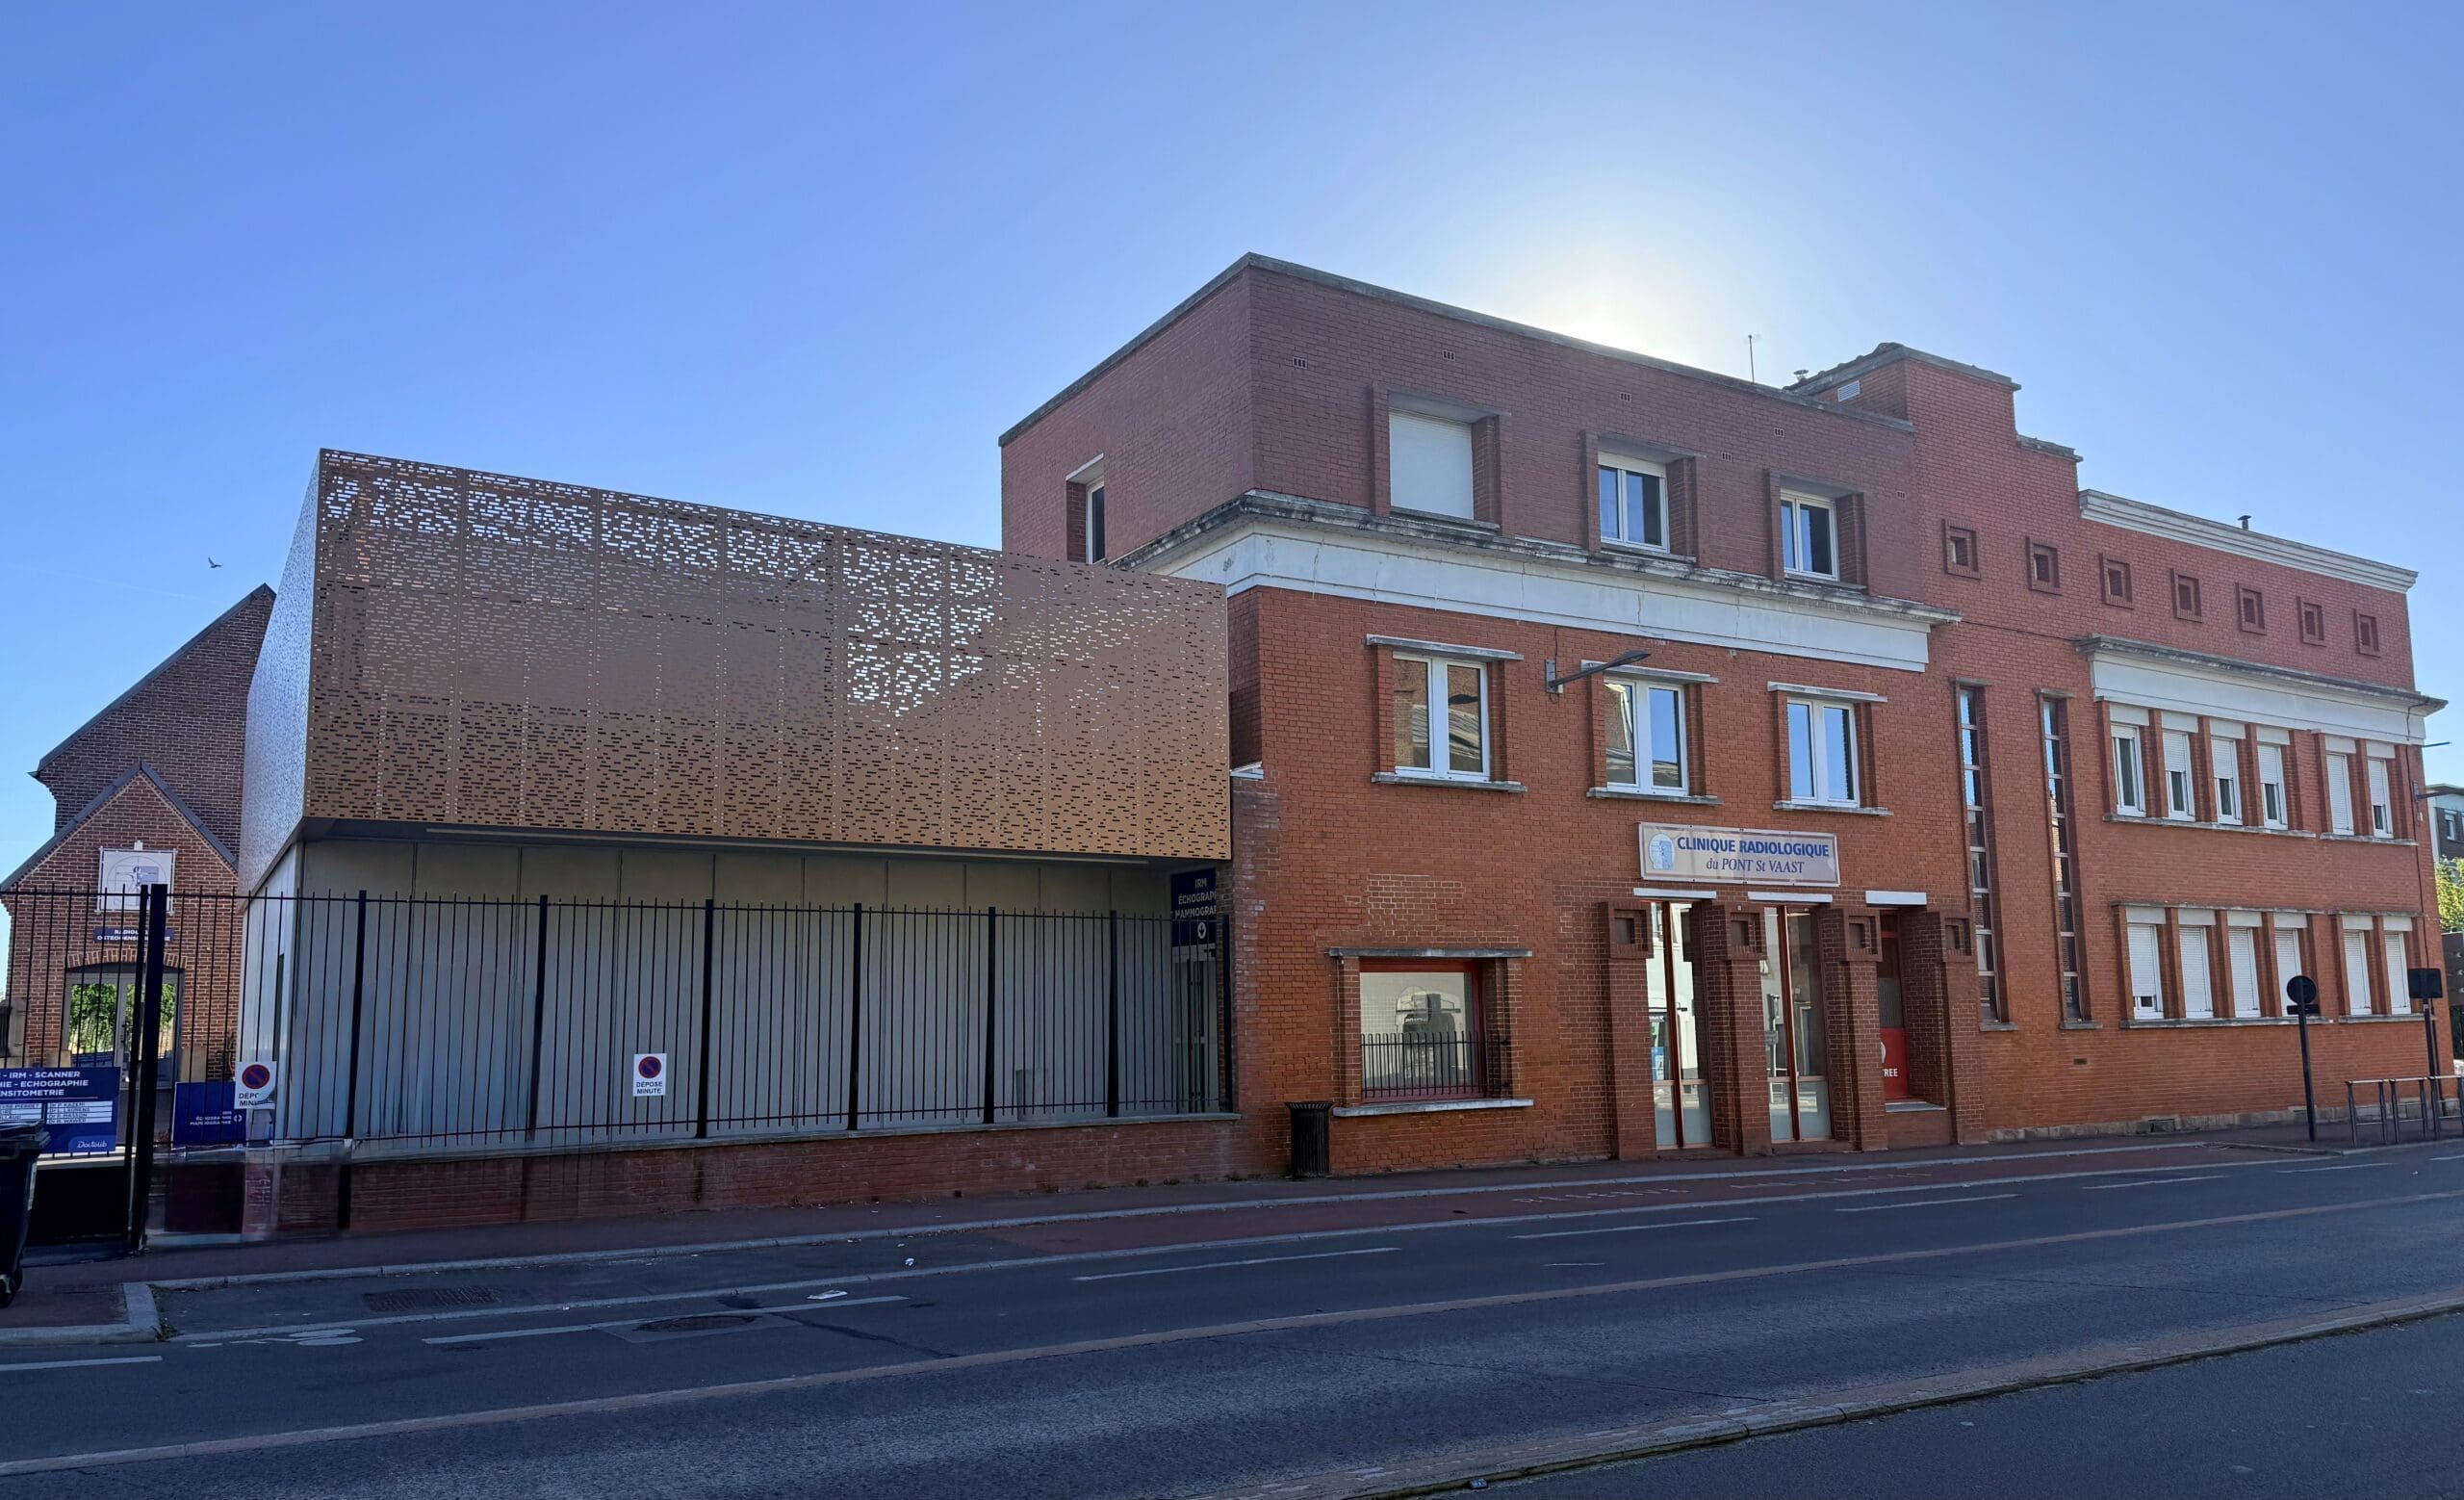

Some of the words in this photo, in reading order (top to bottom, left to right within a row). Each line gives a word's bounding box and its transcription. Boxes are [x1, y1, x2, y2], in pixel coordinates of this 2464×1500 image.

[1677, 837, 1736, 853] CLINIQUE
[1739, 841, 1830, 857] RADIOLOGIQUE
[1706, 857, 1719, 870] du
[1722, 858, 1754, 871] PONT
[1756, 860, 1766, 872] St
[1769, 860, 1805, 874] VAAST
[1194, 877, 1208, 888] IRM
[77, 1140, 108, 1149] Doctolib
